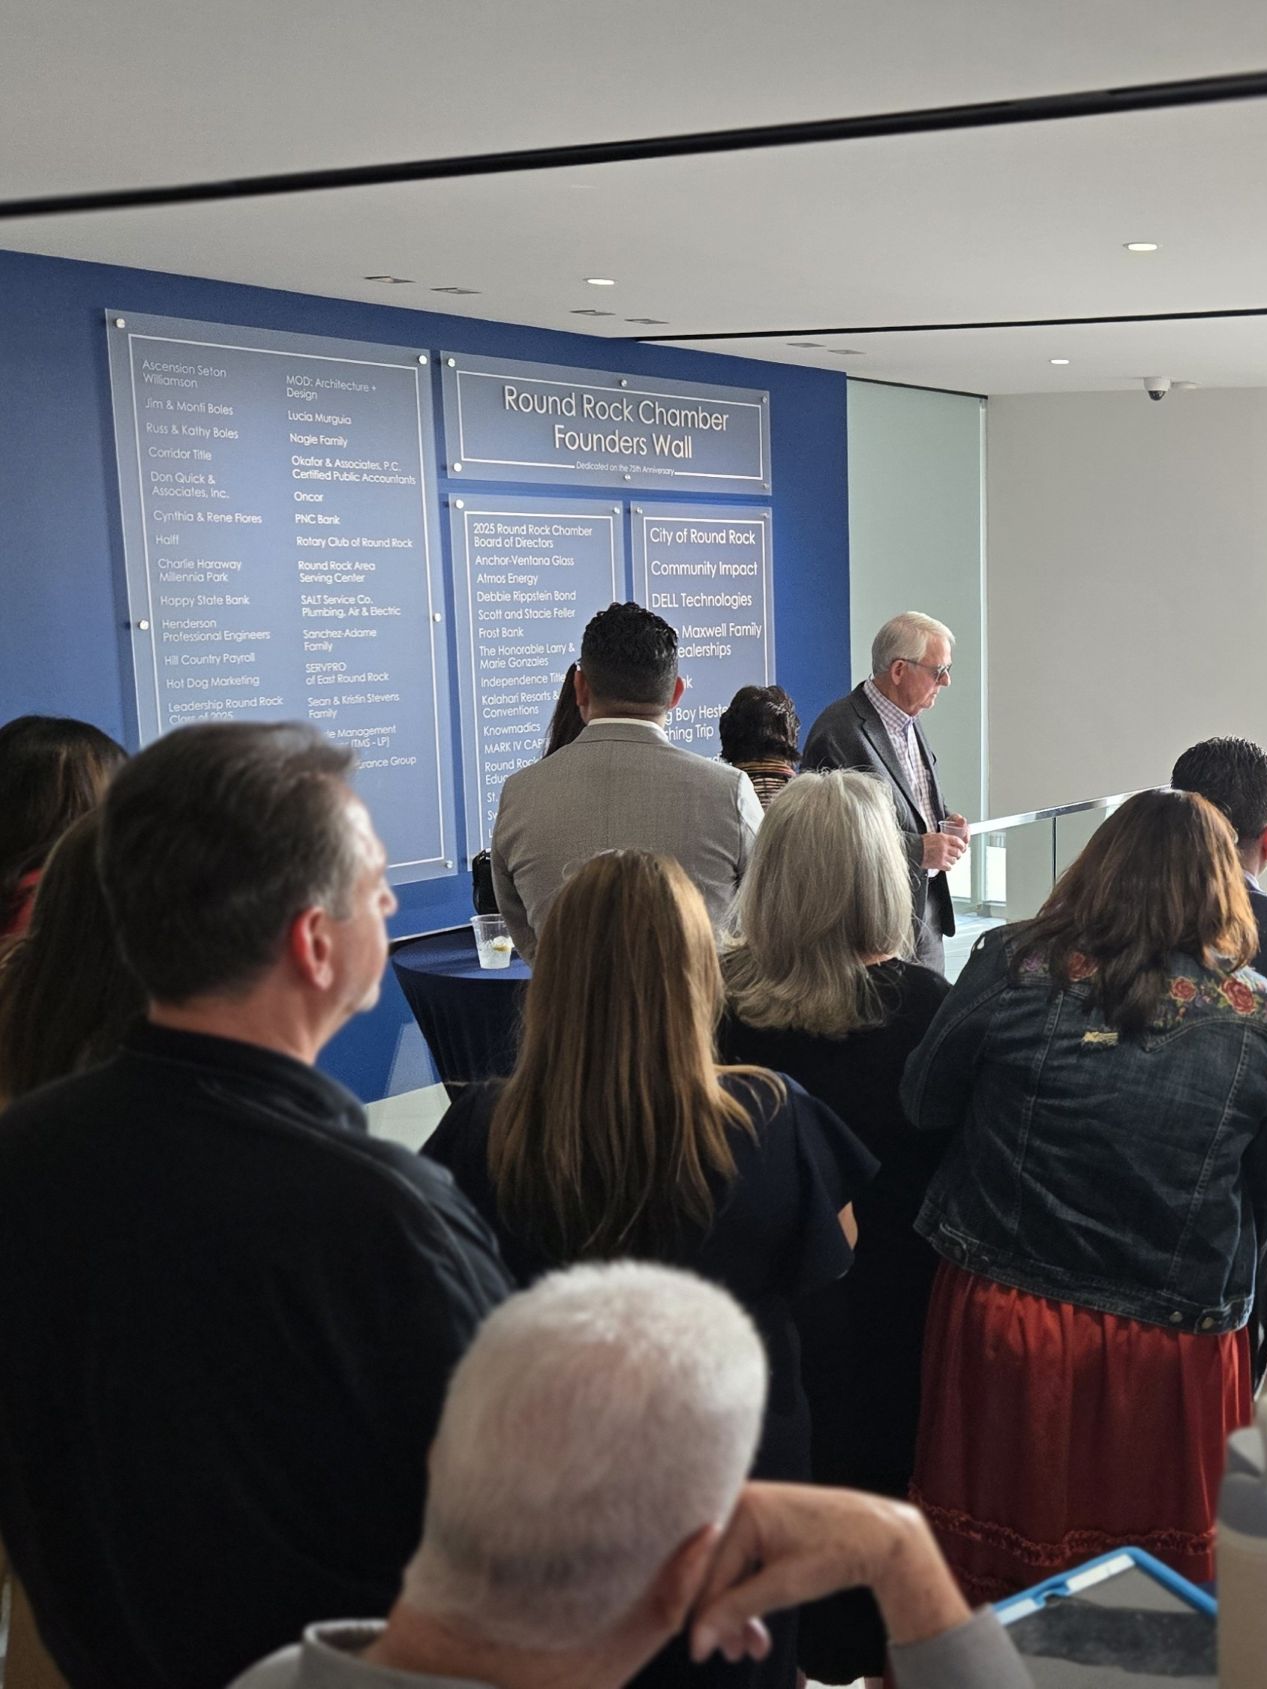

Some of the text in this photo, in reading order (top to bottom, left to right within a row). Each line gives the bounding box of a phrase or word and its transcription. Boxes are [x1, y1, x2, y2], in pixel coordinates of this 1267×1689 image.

[142, 359, 226, 377] Ascension Seton
[143, 373, 198, 388] Williamson
[315, 378, 369, 392] Architecture
[287, 388, 318, 400] Design
[145, 398, 164, 410] Jim
[166, 401, 174, 410] &
[206, 403, 234, 415] Boles
[504, 385, 729, 431] Round Rock Chamber
[288, 411, 352, 426] Lucia Murguia
[146, 423, 239, 439] Russ & Kathy Boles
[319, 435, 348, 448] Family
[554, 424, 693, 459] Founders Wall
[148, 446, 212, 461] Corridor Title
[291, 456, 324, 467] Okafor
[325, 457, 333, 468] &
[576, 461, 608, 472] Dedicated
[618, 463, 628, 473] the
[642, 466, 675, 477] Anniversary
[151, 471, 216, 485] Don Quick &
[292, 469, 417, 485] Certified Public Accountants
[211, 487, 230, 498] Inc.
[294, 491, 323, 503] Oncor
[153, 511, 194, 523] Cynthia
[197, 512, 205, 522] &
[206, 512, 233, 523] Rene
[295, 514, 341, 525] PNC Bank
[473, 523, 592, 536] 2025 Round Rock Chamber
[296, 536, 413, 549] Rotary Club of Round Rock
[474, 537, 553, 548] Board of Directors
[650, 528, 756, 546] City of Round Rock
[158, 559, 242, 572] Charlie Haraway
[298, 560, 376, 571] Round Rock Area
[475, 555, 575, 566] Anchor-Ventana Glass
[651, 561, 758, 579] Community Impact
[207, 572, 229, 583] Park
[299, 573, 365, 585] Serving Center
[476, 573, 538, 586] Atmos Energy
[160, 594, 250, 607] Happy State Bank
[301, 594, 373, 605] SALT Service Co.
[477, 590, 576, 603] Debbie Rippstein Bond
[652, 592, 752, 610] DELL Technologies
[348, 607, 360, 617] Air
[361, 607, 369, 616] &
[370, 606, 401, 616] Electric
[478, 608, 501, 620] Scott
[504, 609, 523, 620] and
[524, 609, 551, 619] Stacie
[162, 618, 217, 629] Henderson
[163, 629, 271, 642] Professional Engineers
[479, 627, 524, 638] Frost Bank
[682, 625, 727, 639] Maxwell
[729, 622, 762, 638] Family
[304, 640, 333, 652] Family
[480, 642, 575, 656] The Honorable Larry &
[676, 643, 731, 660] ealerships
[164, 652, 255, 666] Hill Country Payroll
[480, 656, 549, 669] Marie Gonzales
[305, 662, 347, 673] SERVPRO
[166, 675, 260, 691] Hot Dog Marketing
[306, 671, 390, 685] of East Round Rock
[481, 674, 548, 688] Independence
[168, 696, 283, 713] Leadership Round Rock
[308, 693, 400, 707] Sean & Kristin Stevens
[482, 691, 551, 706] Kalahari Resorts
[309, 707, 338, 720] Family
[483, 704, 539, 719] Conventions
[675, 707, 697, 723] Boy
[699, 704, 728, 718] Heste
[337, 725, 396, 738] Management
[484, 723, 541, 737] Knowmadics
[695, 724, 714, 740] Trip
[484, 742, 522, 754] MARK IV
[390, 755, 417, 767] Group
[485, 759, 515, 772] Round
